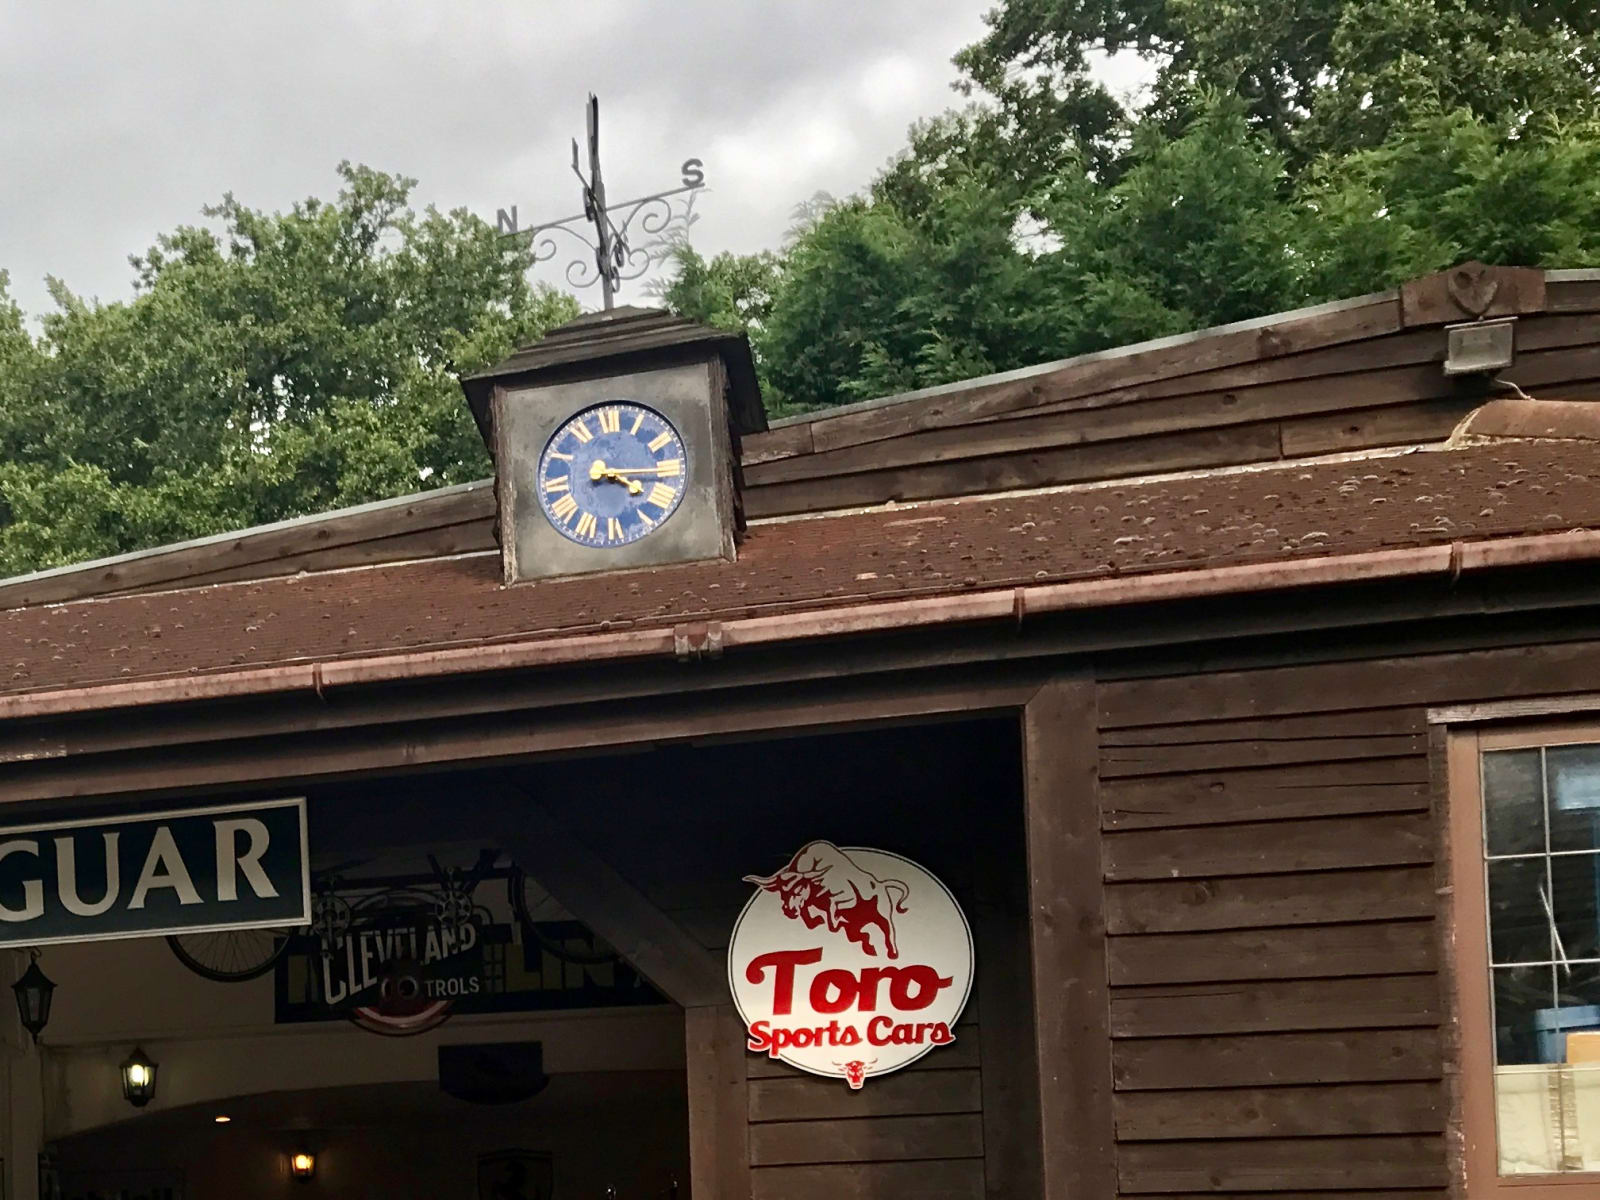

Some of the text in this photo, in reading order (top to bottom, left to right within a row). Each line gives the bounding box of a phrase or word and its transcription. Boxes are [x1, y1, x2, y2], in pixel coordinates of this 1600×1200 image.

[321, 922, 477, 1006] CLEVELAND
[745, 946, 954, 1016] Toro
[748, 1015, 956, 1057] Sports Cars
